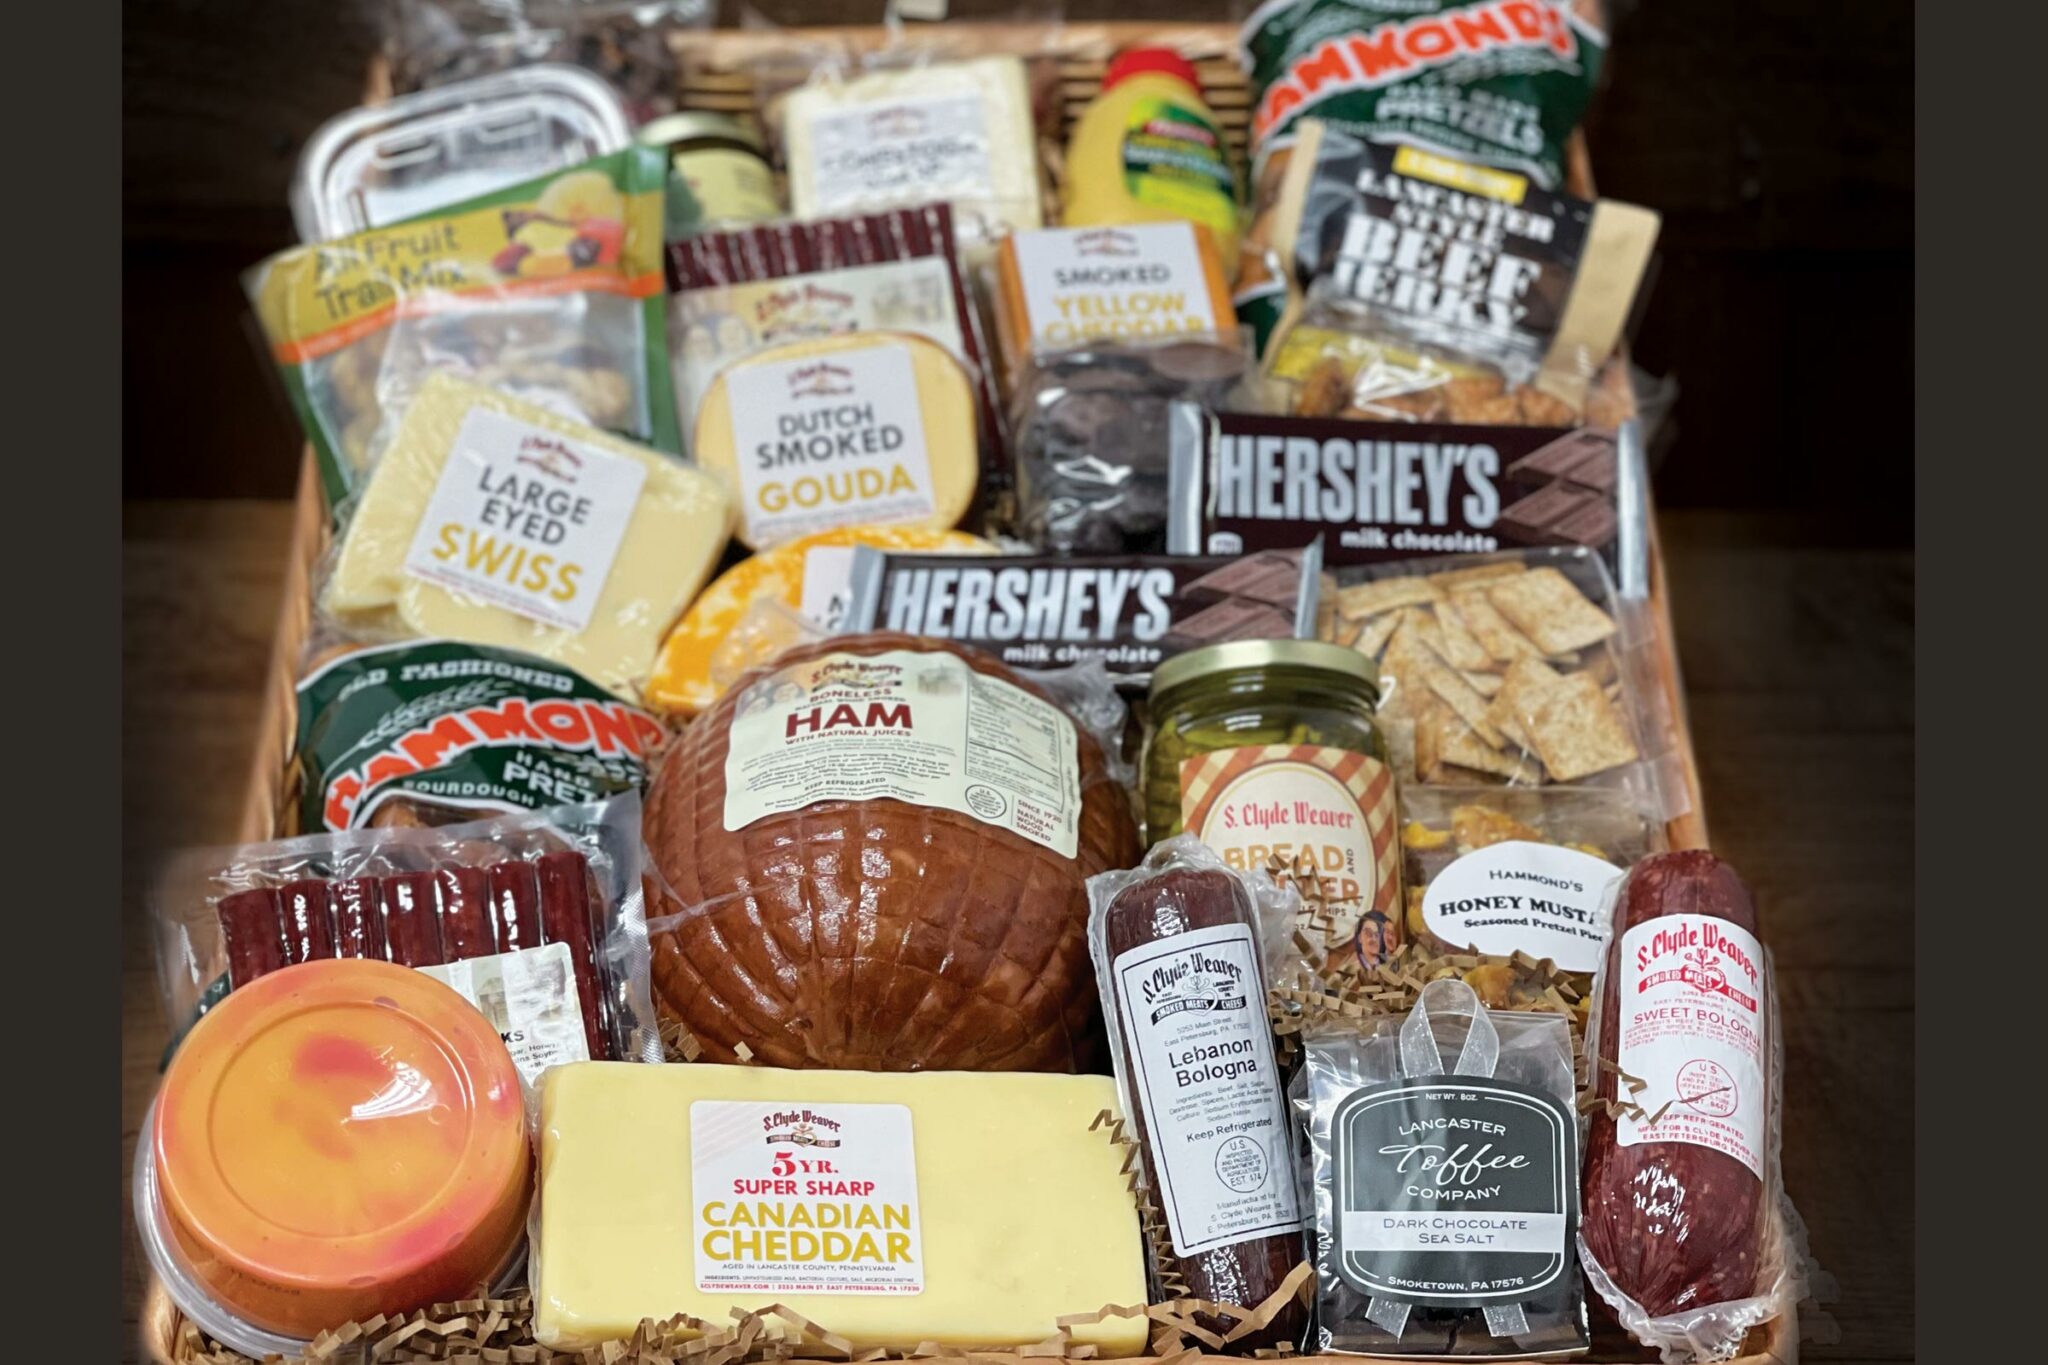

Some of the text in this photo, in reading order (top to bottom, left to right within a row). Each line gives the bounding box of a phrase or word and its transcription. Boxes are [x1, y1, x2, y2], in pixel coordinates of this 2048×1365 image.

[1343, 212, 1541, 299] BEEF
[1054, 263, 1171, 289] SMOKED
[1052, 289, 1186, 319] YELLOW
[1333, 258, 1528, 337] JERKY
[777, 403, 875, 438] DUTCH
[756, 424, 904, 471] SMOKED
[757, 463, 917, 513] GOUDA
[1217, 434, 1500, 529] HERSHEY'S
[478, 464, 593, 526] LARGE
[480, 498, 566, 546] EYED
[1340, 529, 1498, 554] milk chocolate
[431, 522, 583, 605] SWISS
[886, 568, 1175, 641] HERSHEY'S
[1003, 643, 1162, 663] milk cholate
[401, 658, 574, 694] FASHIONED
[809, 687, 893, 704] BONELESS
[785, 702, 914, 739] HAM
[785, 729, 913, 746] WITH NATURAL JUICES
[515, 750, 591, 789] HAND
[804, 780, 824, 792] KEEP
[825, 777, 887, 787] REFRIGERATED
[1017, 799, 1042, 814] SINCE
[1223, 800, 1355, 830] S. Clyde Weaver
[1016, 810, 1056, 832] NATURAL
[1016, 815, 1044, 833] WOOD
[1016, 821, 1052, 843] SMOKED
[1346, 847, 1356, 875] AND
[1488, 869, 1584, 893] HAMMOND'S
[1439, 896, 1524, 917] HONEY
[1463, 917, 1529, 929] Seasoned
[1532, 917, 1577, 936] Pretzel
[1637, 922, 1758, 988] S. Clyde Weaver
[1153, 959, 1189, 993] Clyde
[1191, 952, 1243, 984] Weaver
[1645, 969, 1682, 988] SMOKED
[1157, 997, 1244, 1020] SMOKED MEATS CHEESE
[1634, 1007, 1692, 1025] SWEET
[1168, 1038, 1254, 1069] Lebanon
[1175, 1058, 1257, 1088] Bologna
[1425, 1092, 1443, 1101] NET
[763, 1110, 841, 1133] S. Clyde Weaver
[1186, 1117, 1273, 1143] Keep Refrigerated
[1398, 1117, 1507, 1137] LANCASTER
[1663, 1124, 1681, 1132] FOR
[1642, 1133, 1666, 1141] EAST
[771, 1152, 839, 1177] 5 YR.
[1378, 1143, 1531, 1187] Toffee
[733, 1178, 875, 1197] SUPER SHARP
[1406, 1184, 1502, 1201] COMPANY
[702, 1201, 912, 1230] CANADIAN
[1221, 1209, 1244, 1221] Clyde
[1261, 1212, 1272, 1221] PA
[702, 1229, 914, 1264] CHEDDAR
[803, 1264, 838, 1273] COUNTY,
[1471, 1281, 1490, 1291] PA
[1491, 1276, 1525, 1290] 17576
